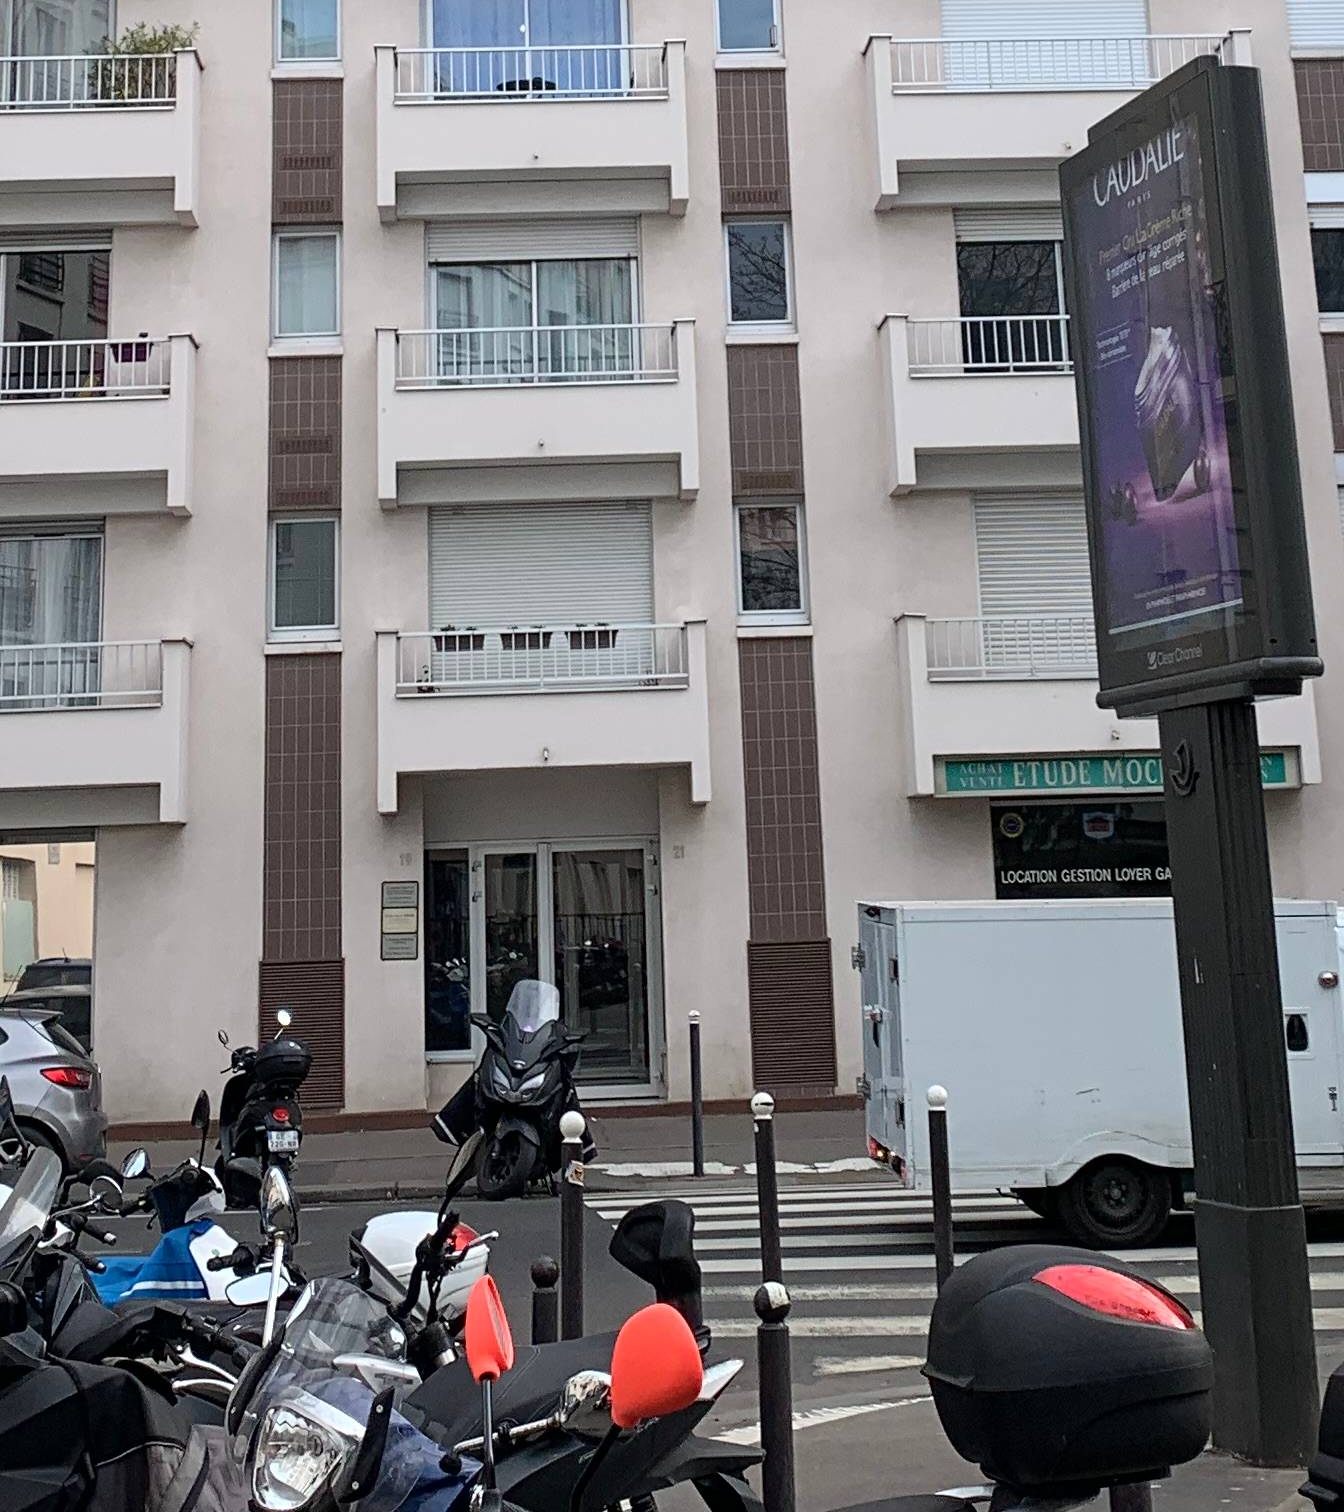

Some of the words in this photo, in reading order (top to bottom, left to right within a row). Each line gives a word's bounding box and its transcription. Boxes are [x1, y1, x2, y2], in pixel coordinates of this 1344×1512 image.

[1093, 127, 1184, 206] CAUDALIE
[1013, 760, 1091, 787] ETUDE
[1103, 759, 1164, 786] MOC
[1001, 869, 1057, 884] LOCATION
[1061, 868, 1111, 883] GESTION
[1115, 867, 1152, 881] LOYER
